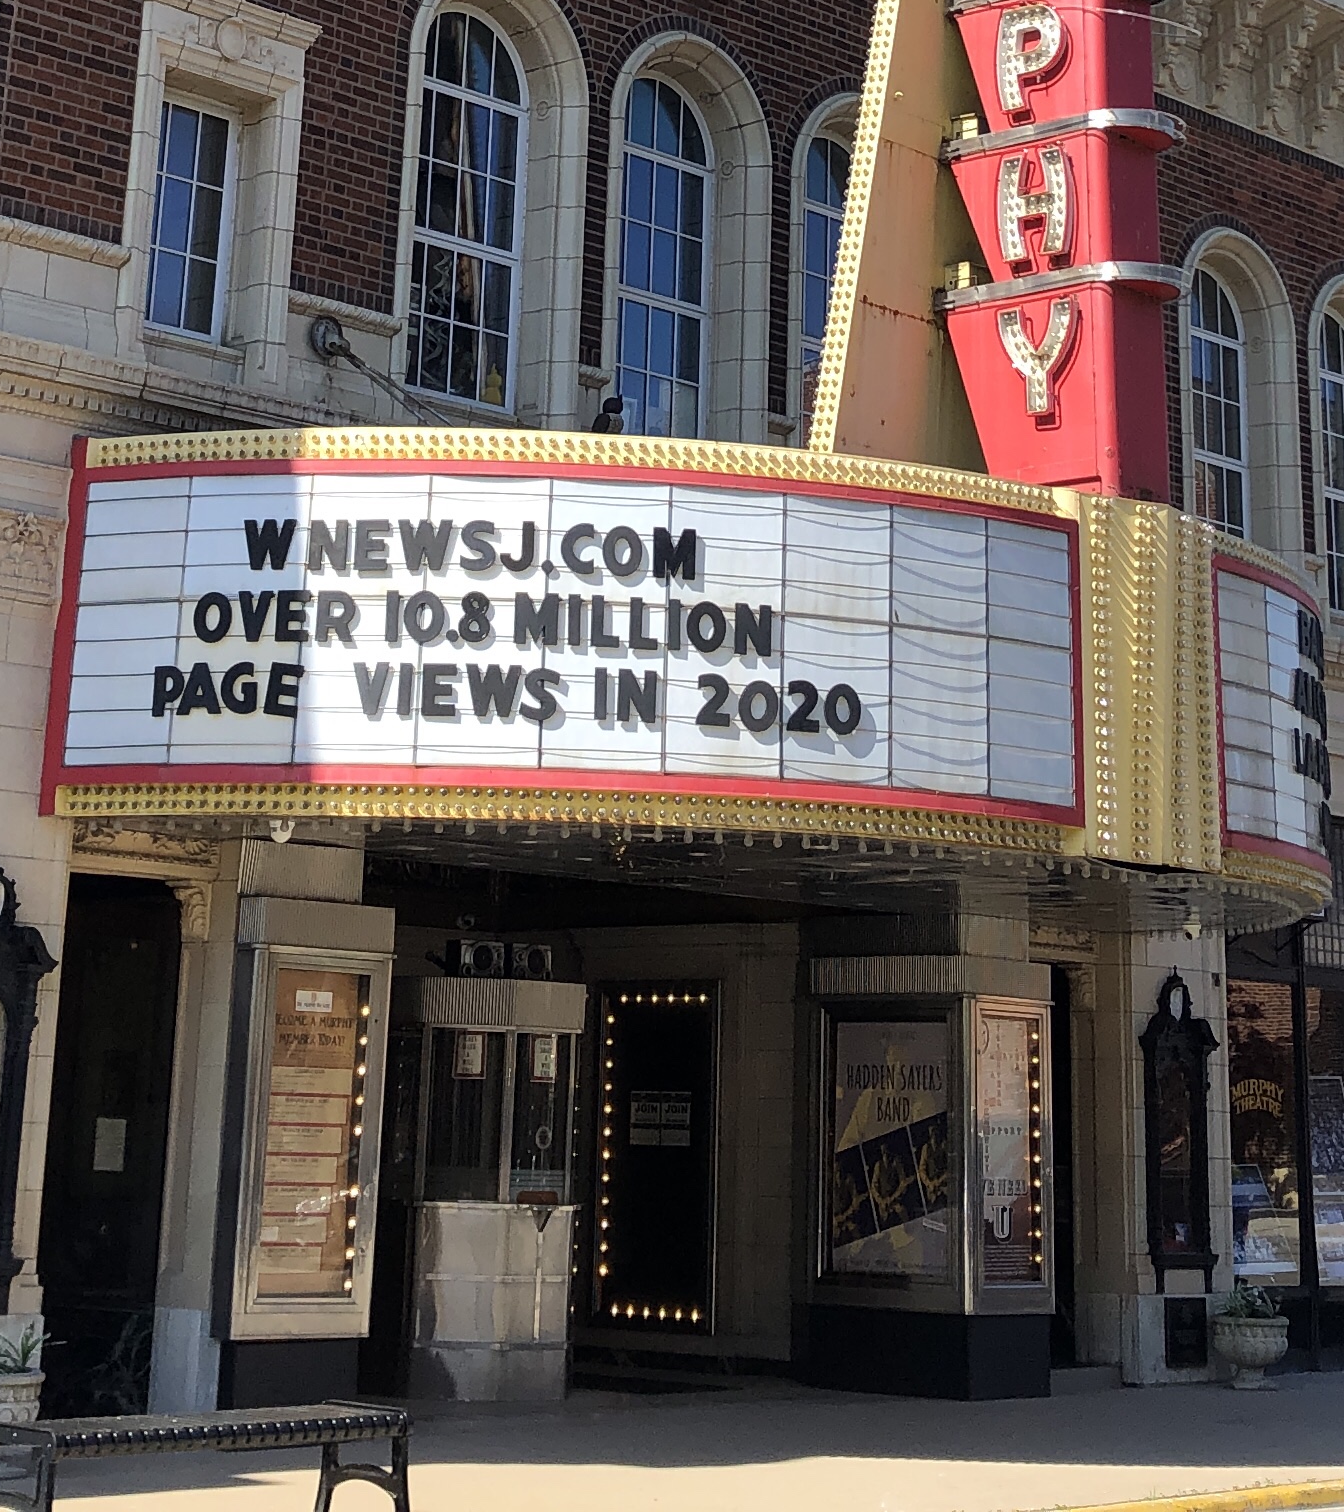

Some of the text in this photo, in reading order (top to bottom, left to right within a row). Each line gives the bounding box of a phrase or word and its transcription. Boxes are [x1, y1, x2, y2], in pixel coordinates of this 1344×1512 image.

[244, 517, 698, 582] WNEWSJ.COM
[193, 589, 773, 657] OVER 10.8 MILLION
[152, 661, 863, 736] PAGE VIEWS IN 2020
[847, 1063, 943, 1091] HADDEN SAYERS
[1230, 1078, 1284, 1102] MURPHY
[635, 1103, 657, 1113] JOIN
[664, 1104, 688, 1114] JOIN
[877, 1096, 910, 1122] BAND
[1234, 1094, 1284, 1119] THEATRE
